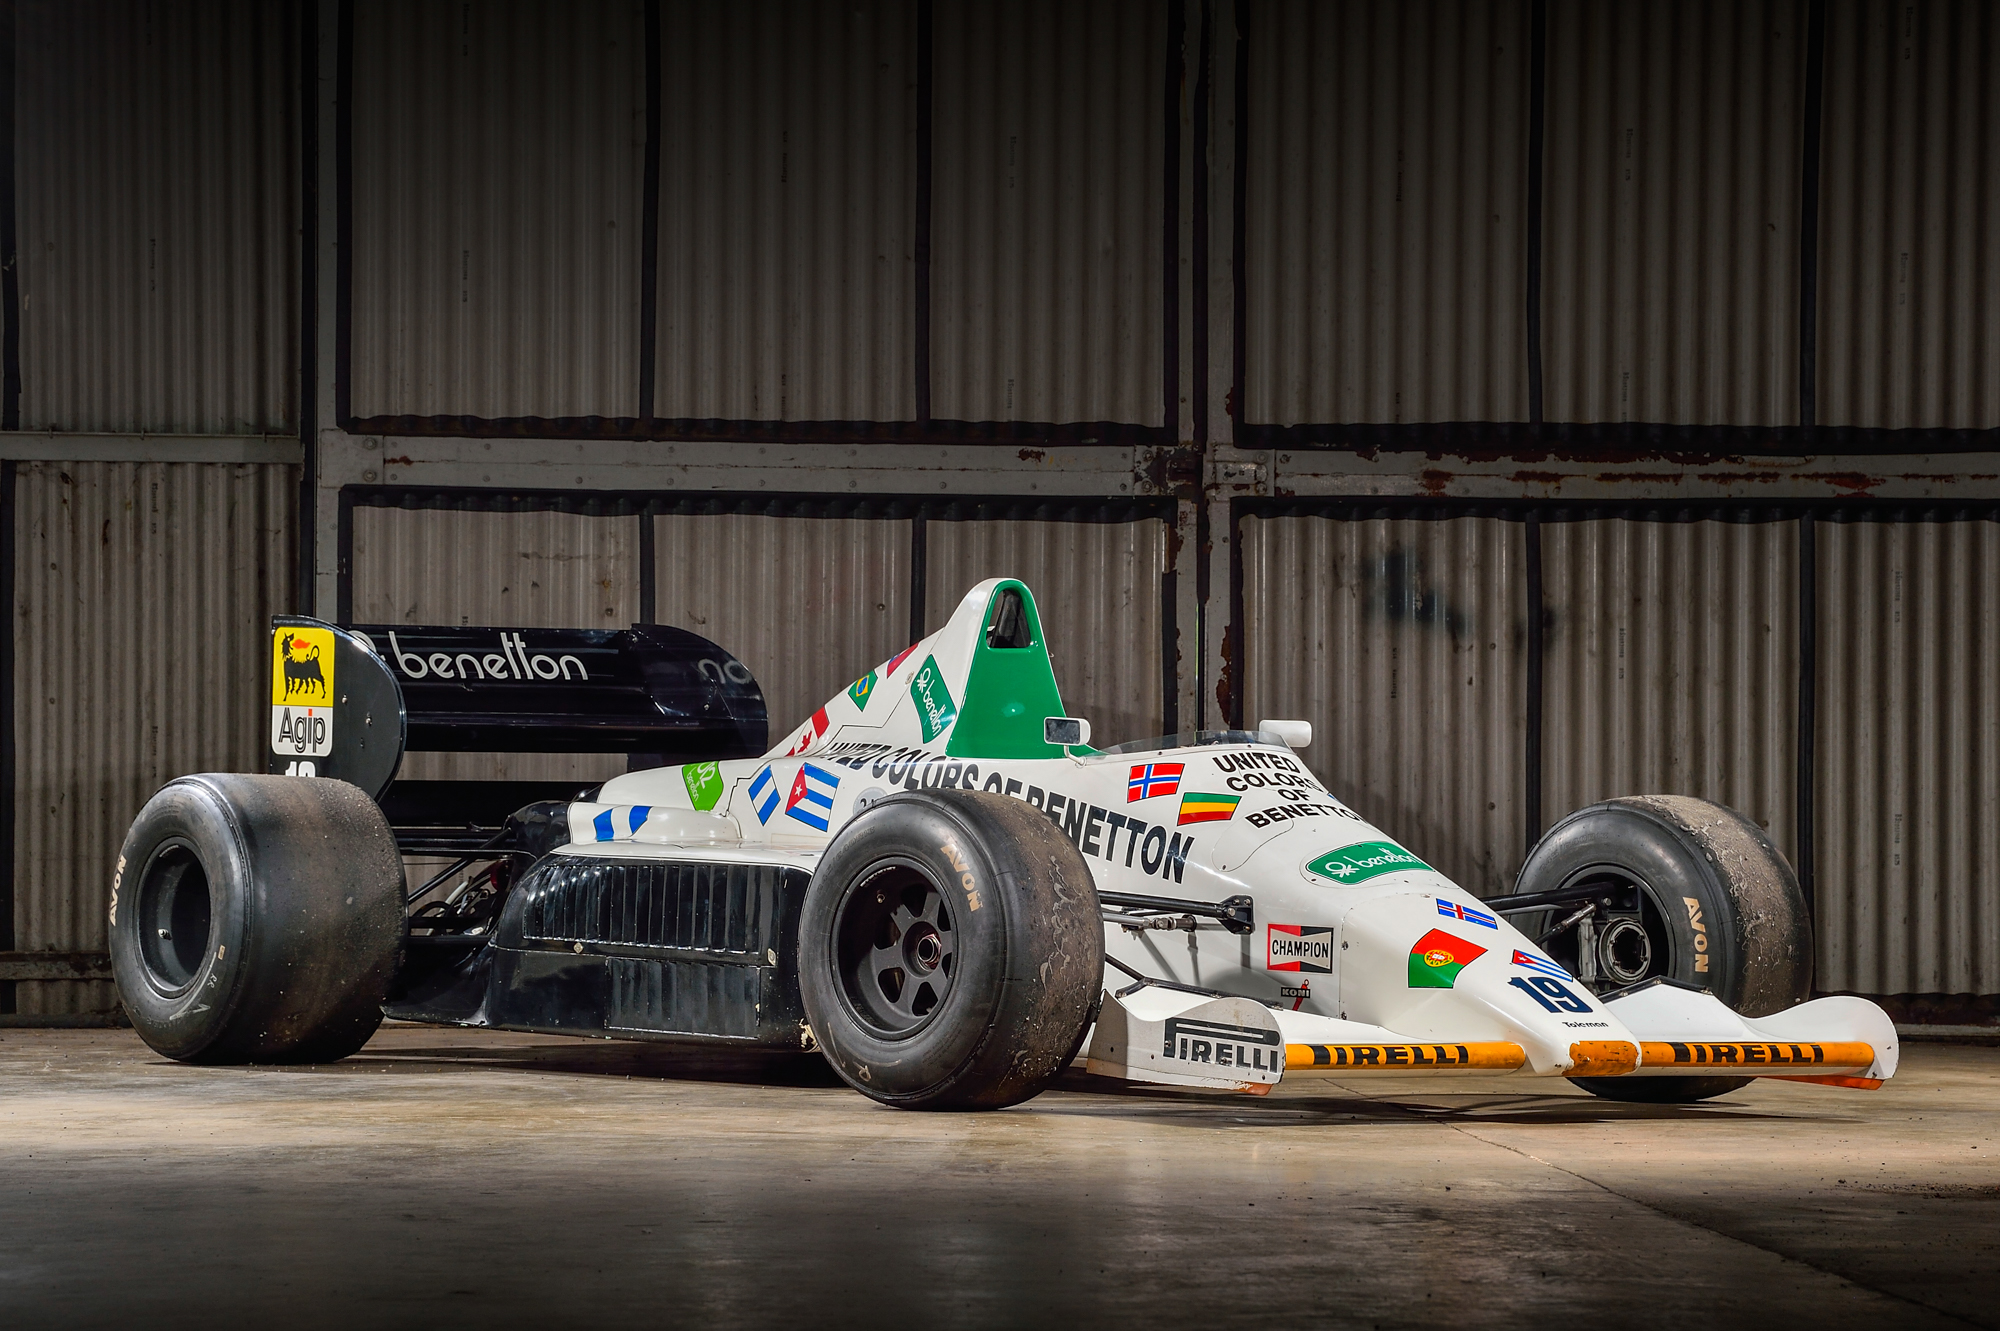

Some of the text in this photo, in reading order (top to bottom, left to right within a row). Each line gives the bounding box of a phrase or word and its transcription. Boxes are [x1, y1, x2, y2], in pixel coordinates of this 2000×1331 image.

[388, 631, 589, 680] benetton
[923, 679, 947, 736] benetton
[278, 707, 326, 753] Agip
[1212, 752, 1301, 774] UNITED
[1226, 772, 1324, 792] COLORS
[1277, 788, 1311, 801] OF
[1245, 803, 1369, 829] BENETTO
[1343, 847, 1422, 868] benetton
[109, 855, 127, 927] AVON
[940, 843, 984, 912] AVON
[1272, 939, 1329, 958] CHAMPION
[1682, 896, 1709, 973] AVON
[1282, 988, 1310, 997] KONI
[1507, 976, 1594, 1013] 19
[1163, 1017, 1281, 1073] PIRELLI
